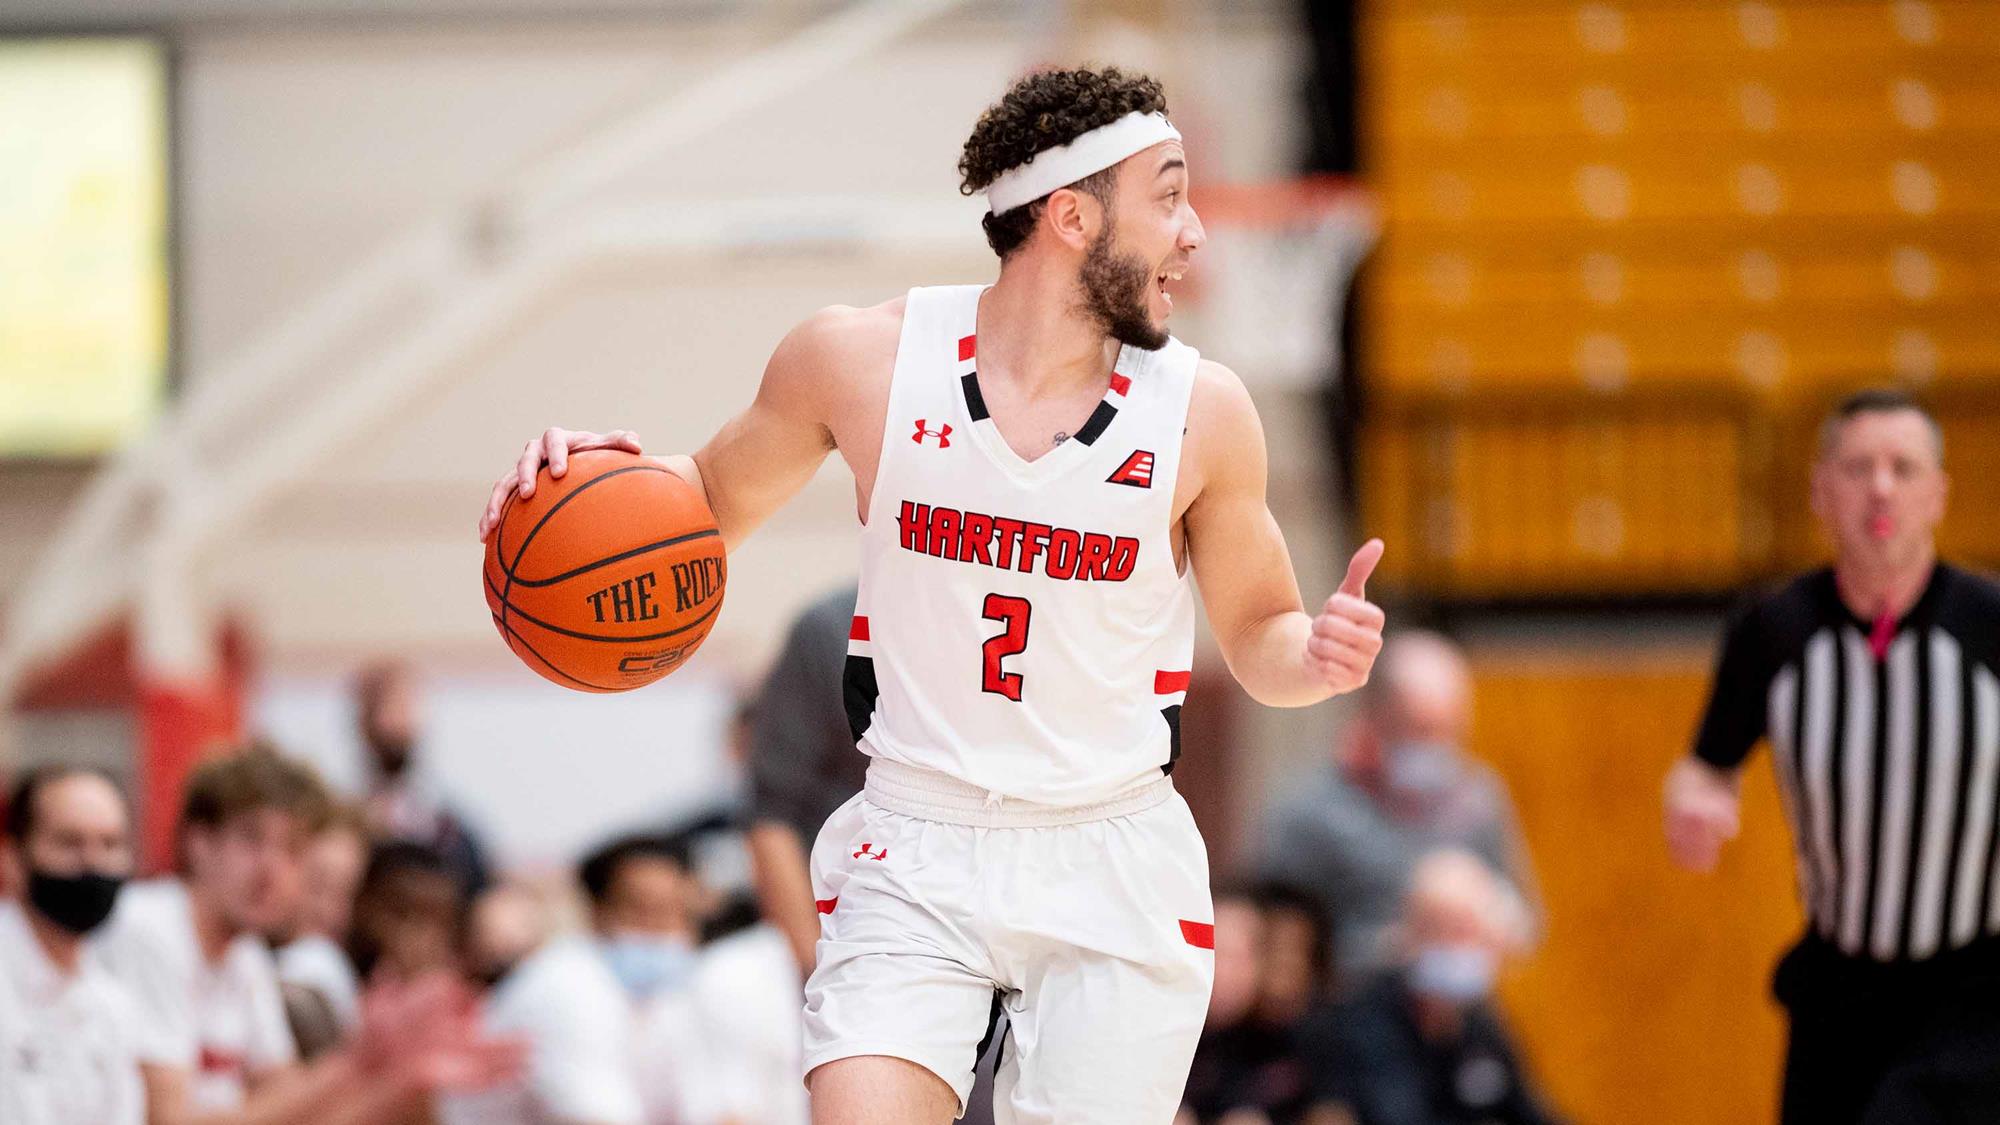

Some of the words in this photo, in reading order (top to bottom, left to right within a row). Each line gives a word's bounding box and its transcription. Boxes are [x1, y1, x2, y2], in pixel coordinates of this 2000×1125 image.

[896, 499, 1140, 582] HARTFORD
[586, 571, 659, 623] THE
[670, 556, 724, 613] ROCK
[981, 593, 1032, 702] 2
